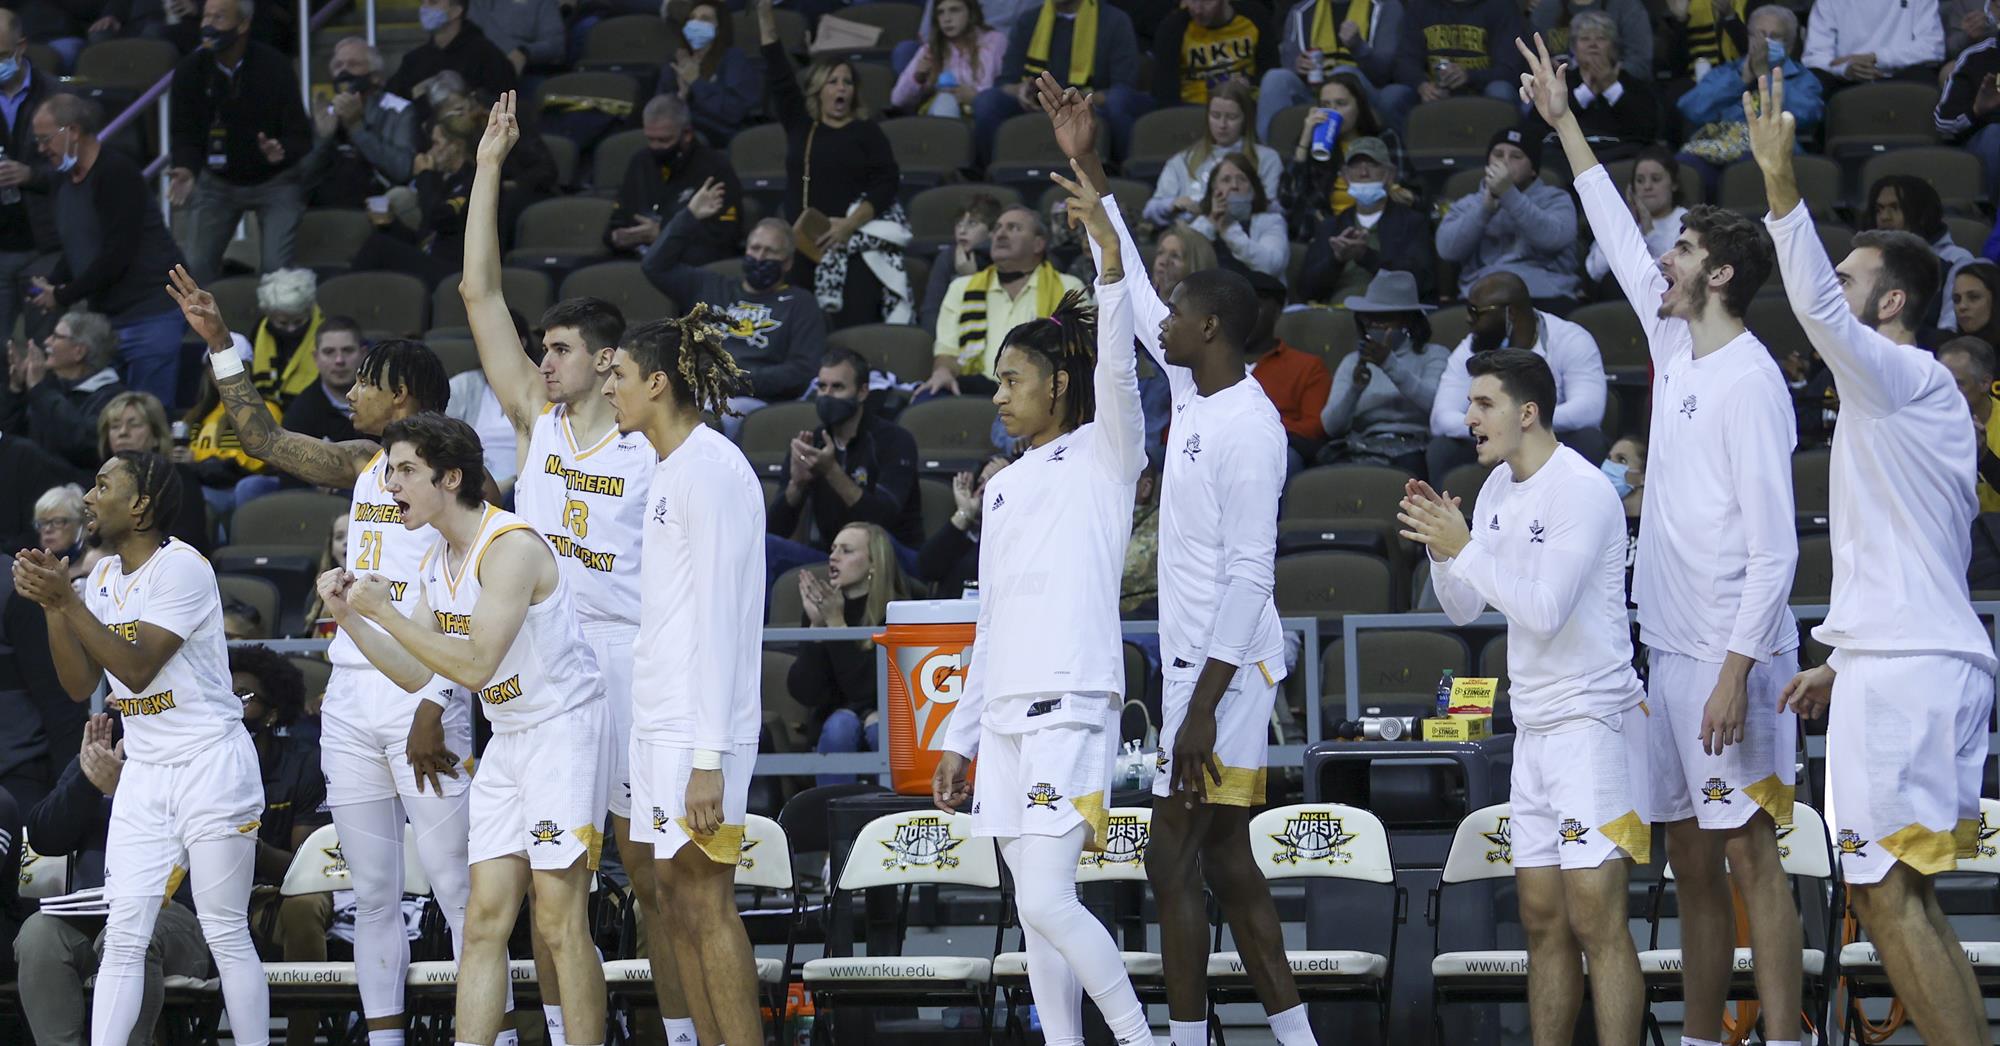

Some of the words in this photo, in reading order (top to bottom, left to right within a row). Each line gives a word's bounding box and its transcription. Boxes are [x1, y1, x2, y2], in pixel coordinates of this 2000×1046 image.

[1190, 38, 1250, 66] NKU
[355, 530, 383, 571] 21
[920, 653, 964, 704] G
[909, 818, 938, 826] NKU
[1109, 817, 1136, 825] NKU
[1300, 812, 1329, 821] NKU
[897, 825, 949, 842] NORSE
[1108, 824, 1147, 840] ORSE
[1286, 820, 1342, 836] NORSE
[829, 963, 936, 977] www.nku.edu
[1465, 958, 1529, 972] www.nk
[265, 969, 342, 982] w.nku.edu
